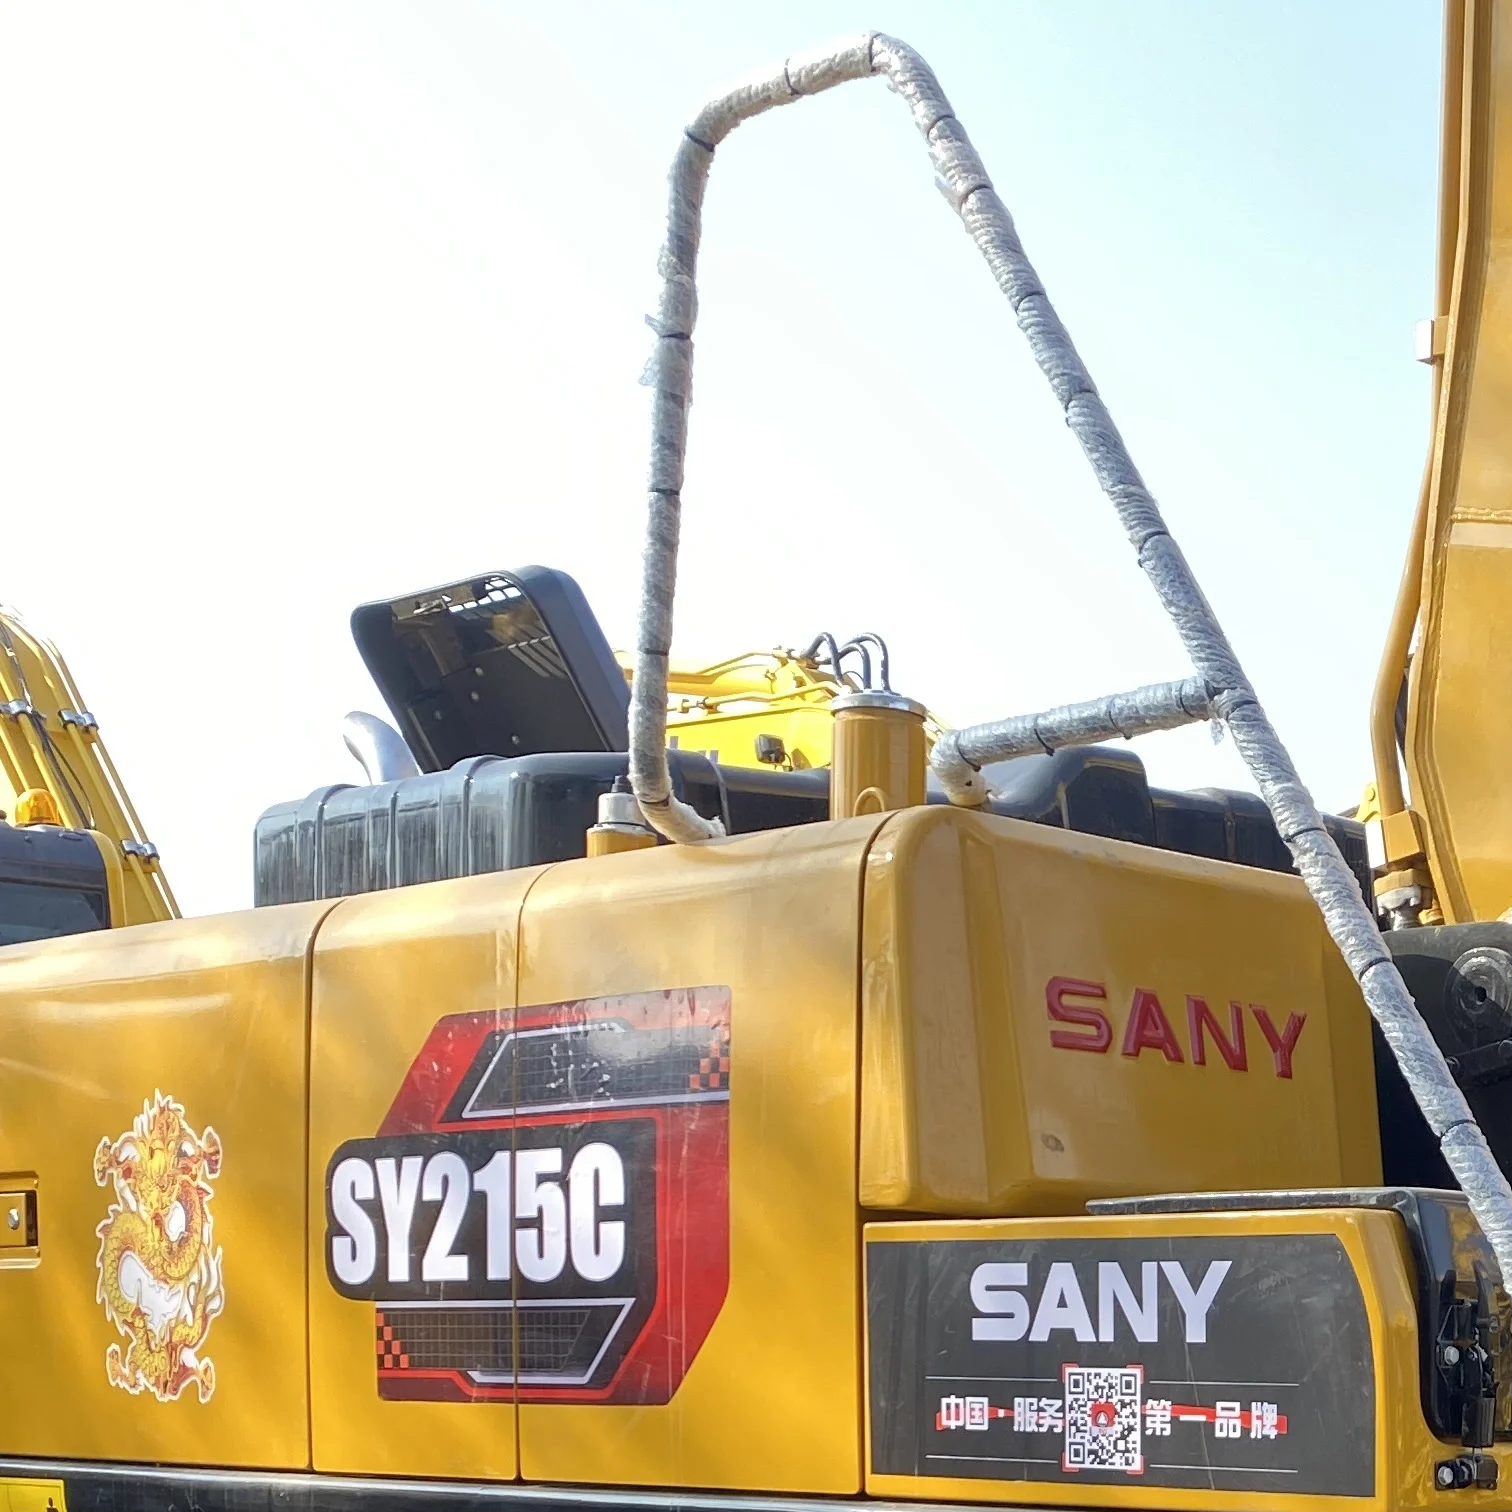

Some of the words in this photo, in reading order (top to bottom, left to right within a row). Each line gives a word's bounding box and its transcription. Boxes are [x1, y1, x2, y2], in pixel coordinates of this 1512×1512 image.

[1046, 976, 1307, 1079] SANY
[332, 1142, 625, 1285] SY215C
[970, 1260, 1233, 1343] SANY
[1144, 1398, 1279, 1440] 第一品牌
